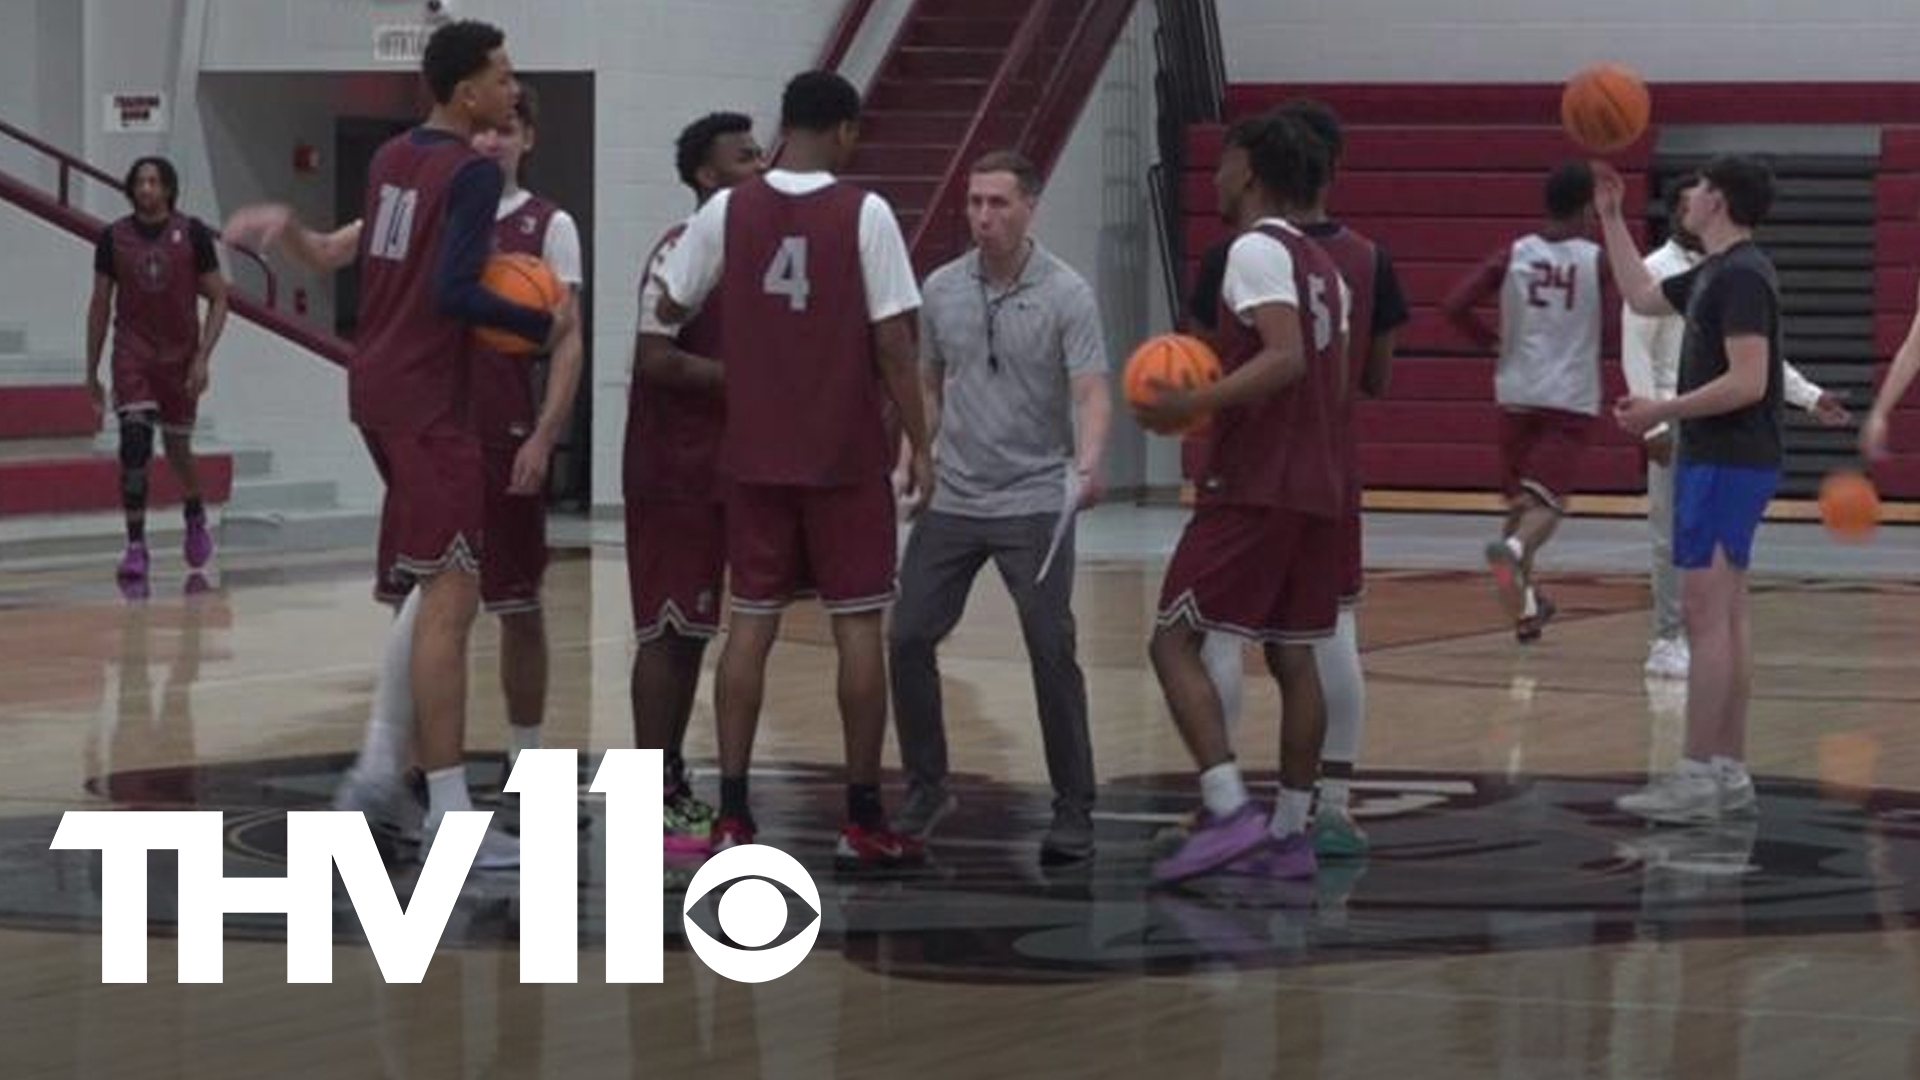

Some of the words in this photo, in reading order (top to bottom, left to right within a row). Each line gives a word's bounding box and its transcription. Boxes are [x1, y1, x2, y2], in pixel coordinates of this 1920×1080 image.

[763, 235, 809, 311] 4
[1307, 272, 1331, 350] 5
[1527, 260, 1577, 311] 24
